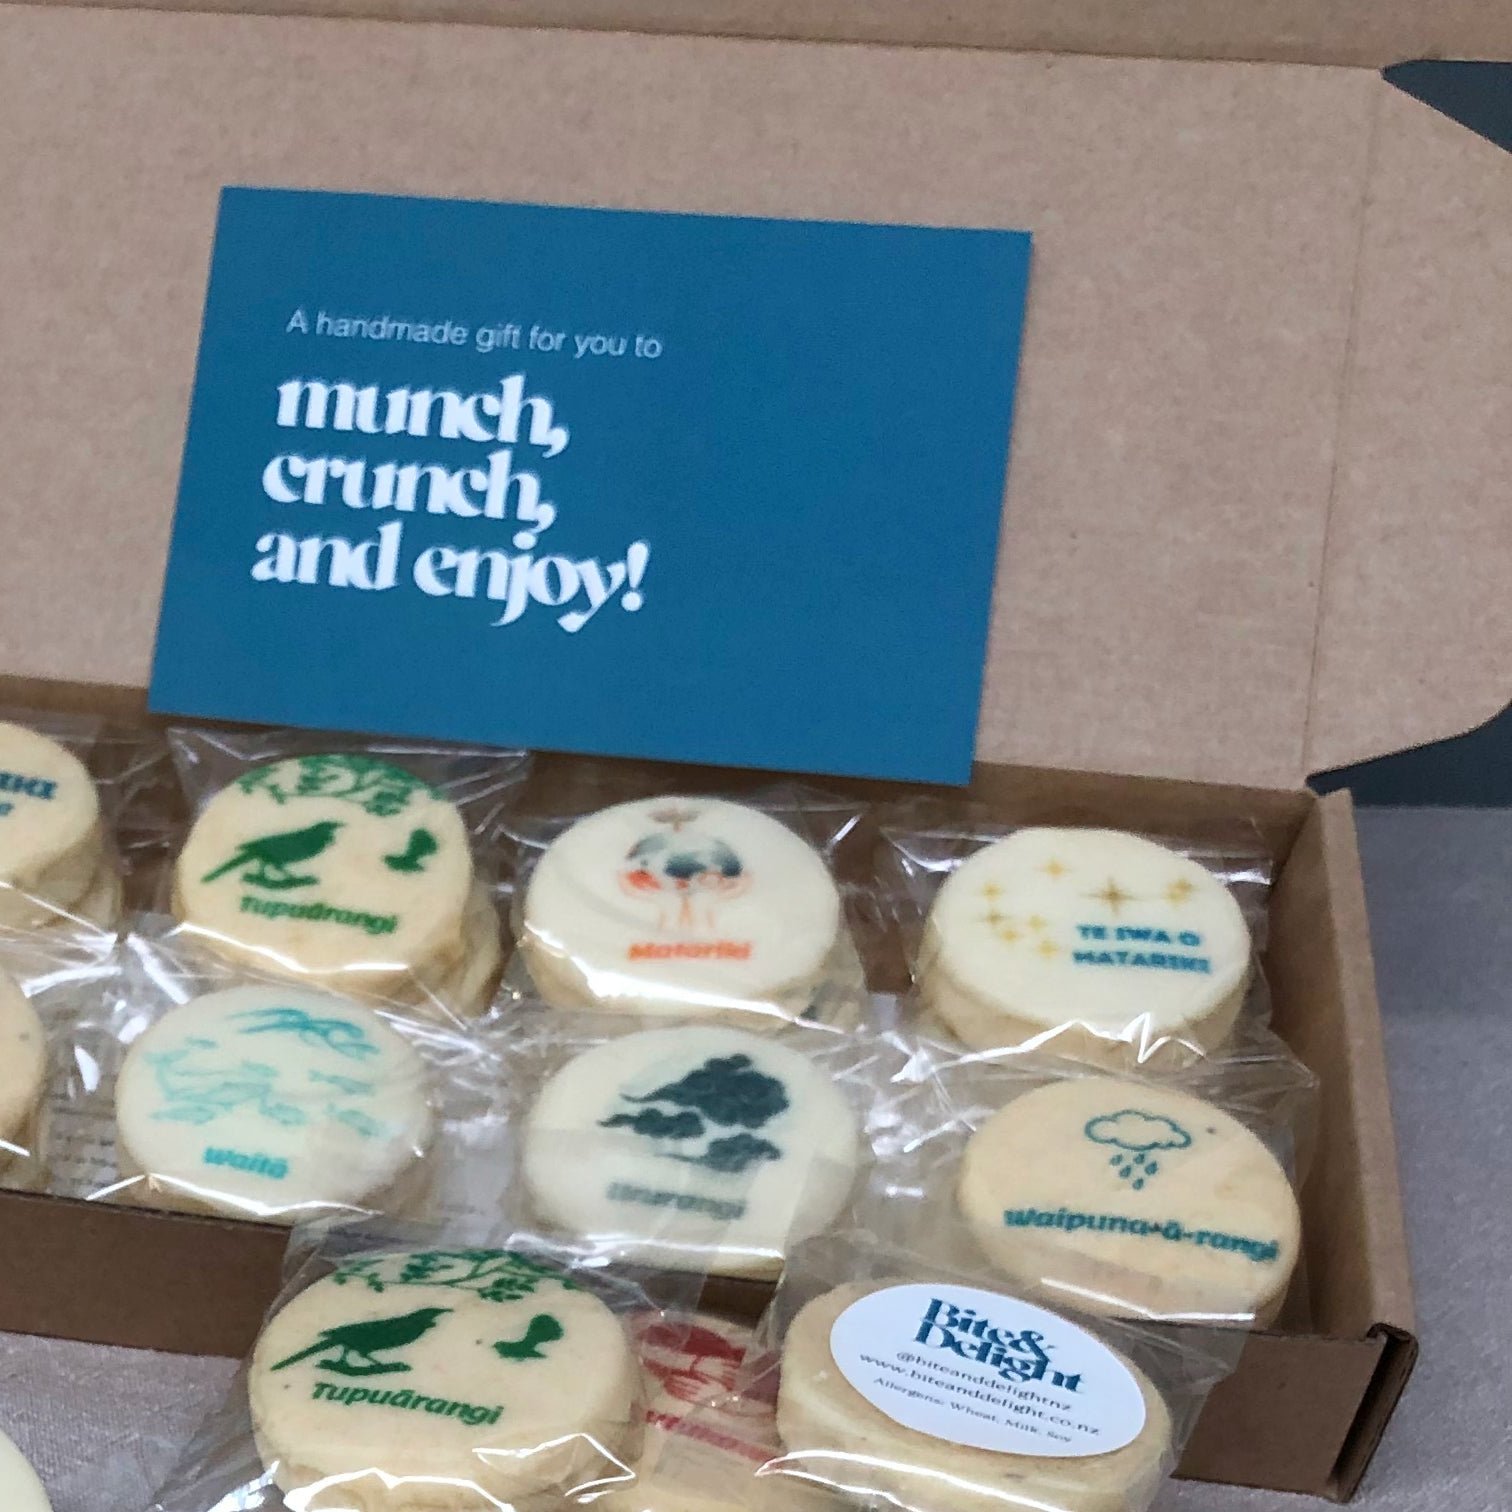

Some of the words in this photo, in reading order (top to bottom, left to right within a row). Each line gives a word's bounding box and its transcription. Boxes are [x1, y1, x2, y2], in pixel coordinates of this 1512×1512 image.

[286, 309, 309, 335] A
[315, 311, 467, 347] handmade
[475, 322, 521, 354] gift
[528, 323, 566, 352] for
[573, 333, 626, 359] you
[634, 333, 663, 358] to
[276, 372, 569, 457] munch,
[262, 451, 557, 534] crunch,
[251, 521, 403, 592] and
[413, 528, 650, 634] enjoy!
[627, 940, 753, 961] Matariki
[1072, 950, 1211, 974] MATARIKI
[1076, 924, 1112, 943] TE
[1116, 926, 1172, 946] IWA
[1176, 930, 1201, 948] O
[922, 1298, 1055, 1354] Bite&
[914, 1320, 1084, 1393] Delight
[312, 1381, 505, 1427] Tupuārangi
